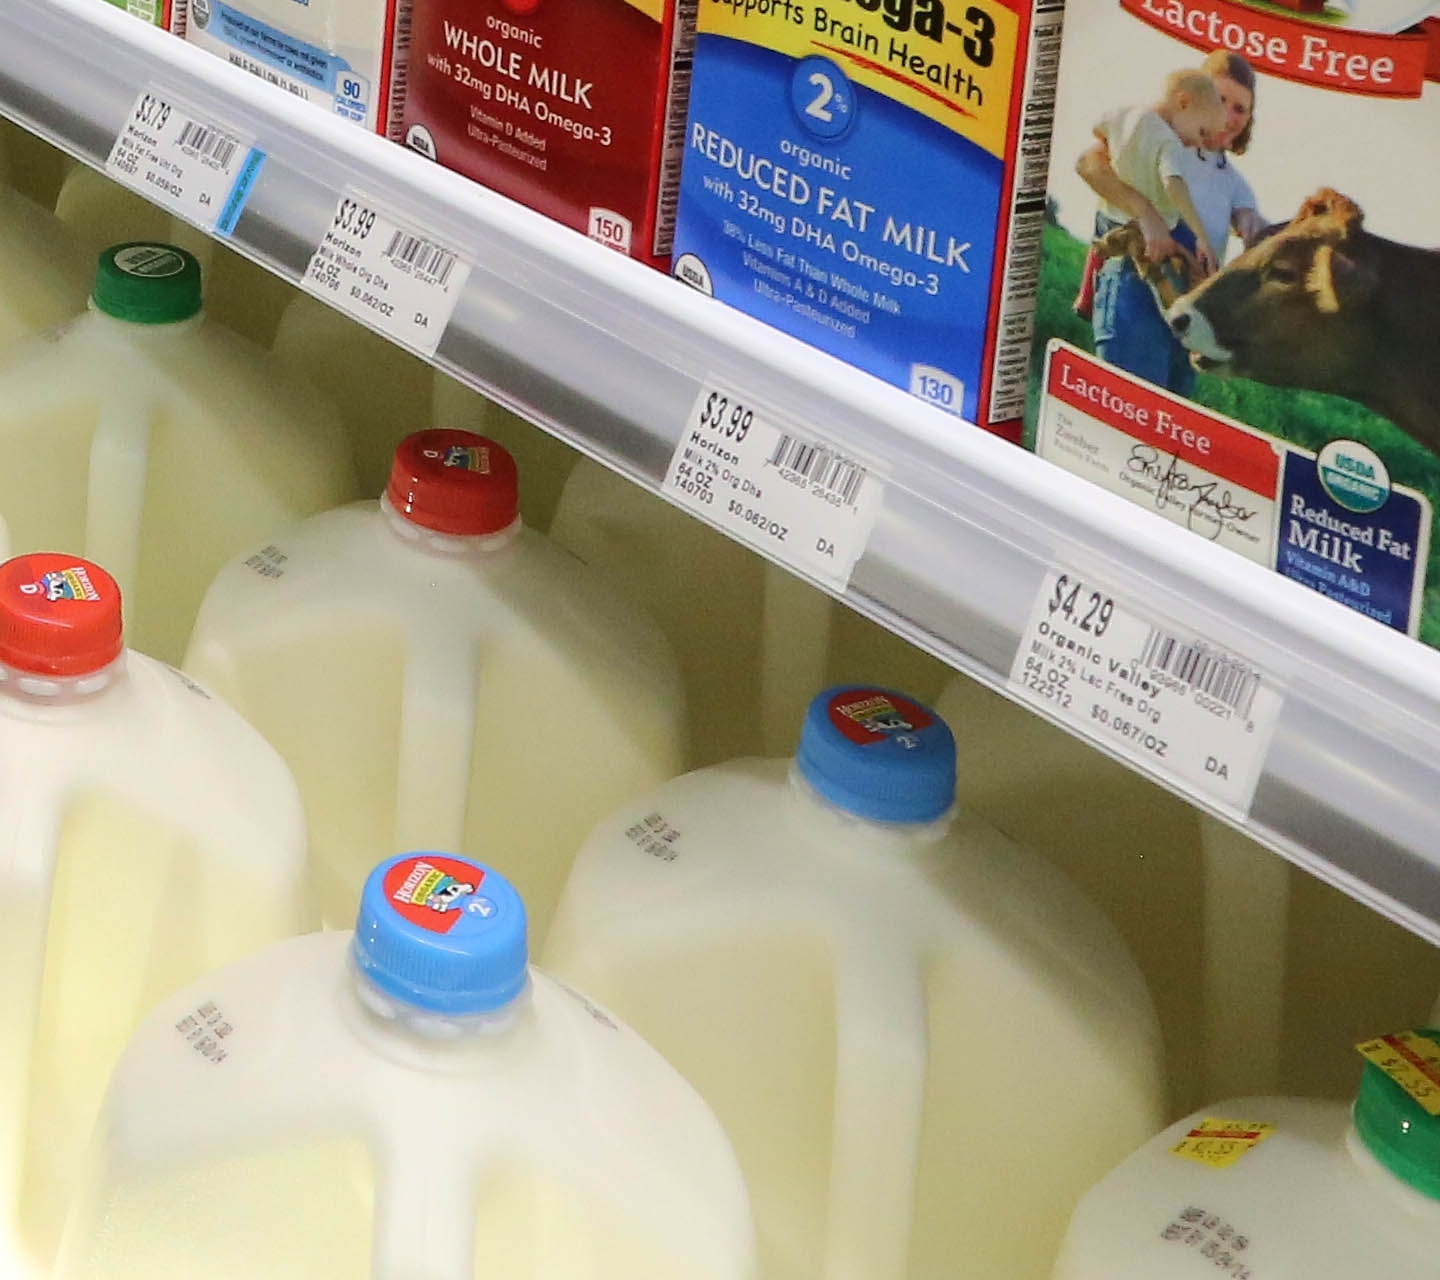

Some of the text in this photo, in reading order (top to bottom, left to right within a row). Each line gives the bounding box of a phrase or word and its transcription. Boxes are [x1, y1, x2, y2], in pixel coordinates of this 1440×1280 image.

[486, 15, 543, 48] organic
[443, 20, 593, 110] WHOLE MILK
[1297, 34, 1397, 86] Free
[134, 93, 171, 132] $3.79
[427, 53, 613, 146] with 32mg DHA Omega-3
[333, 198, 376, 240] $3.99
[691, 122, 972, 274] REDUCED FAT MILK
[593, 216, 624, 244] 150
[919, 374, 953, 405] 130
[1060, 364, 1150, 428] Lactose
[1156, 408, 1212, 457] Free
[700, 391, 754, 443] $3.99
[690, 431, 740, 466] Horizon
[677, 462, 713, 490] 64 OZ
[675, 475, 835, 558] 140703 $0.062/OZ DA
[1289, 493, 1413, 562] Reduced Fat
[1288, 519, 1364, 574] Milk
[1049, 574, 1114, 638] $4.29
[1038, 621, 1162, 699] Organic Valley
[1022, 672, 1229, 781] 122512 $0.067/OZ DA
[393, 861, 433, 904] HORIZON
